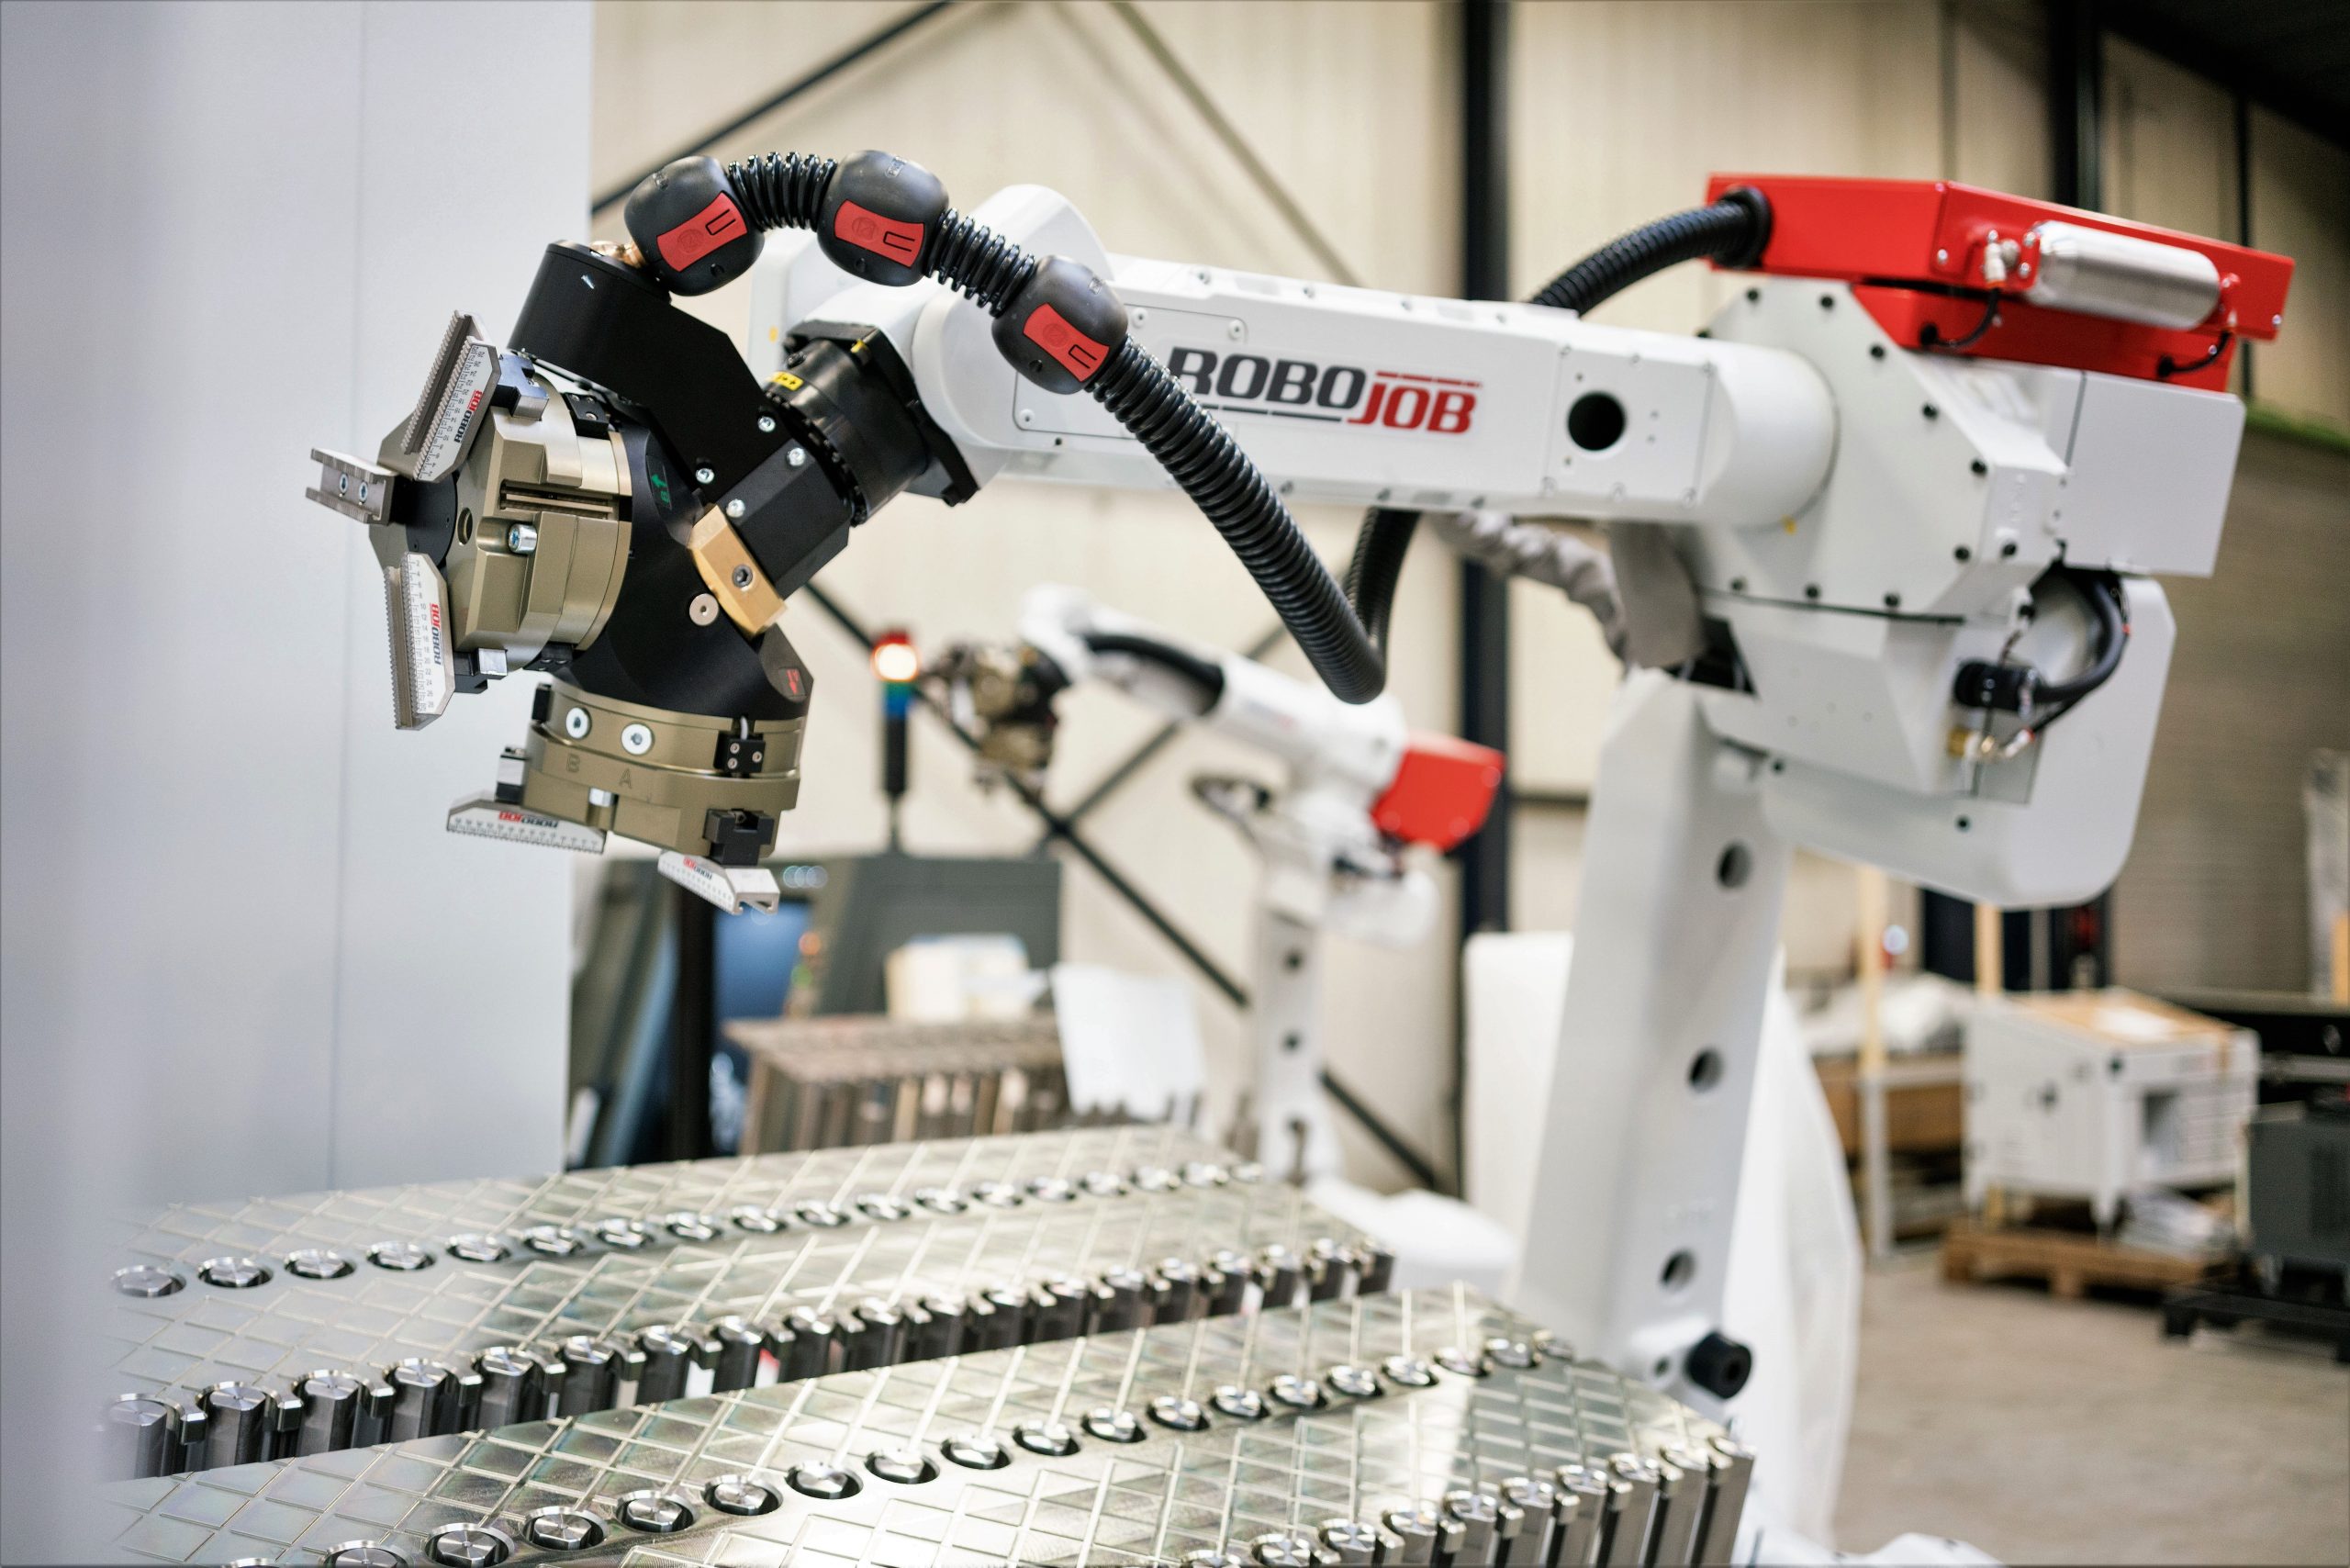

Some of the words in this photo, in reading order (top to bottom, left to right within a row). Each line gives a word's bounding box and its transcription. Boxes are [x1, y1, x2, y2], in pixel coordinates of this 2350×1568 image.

[454, 389, 484, 443] ROBOJOB
[1167, 345, 1479, 435] ROBOJOB
[430, 602, 442, 666] ROBOJOB
[618, 767, 632, 790] A
